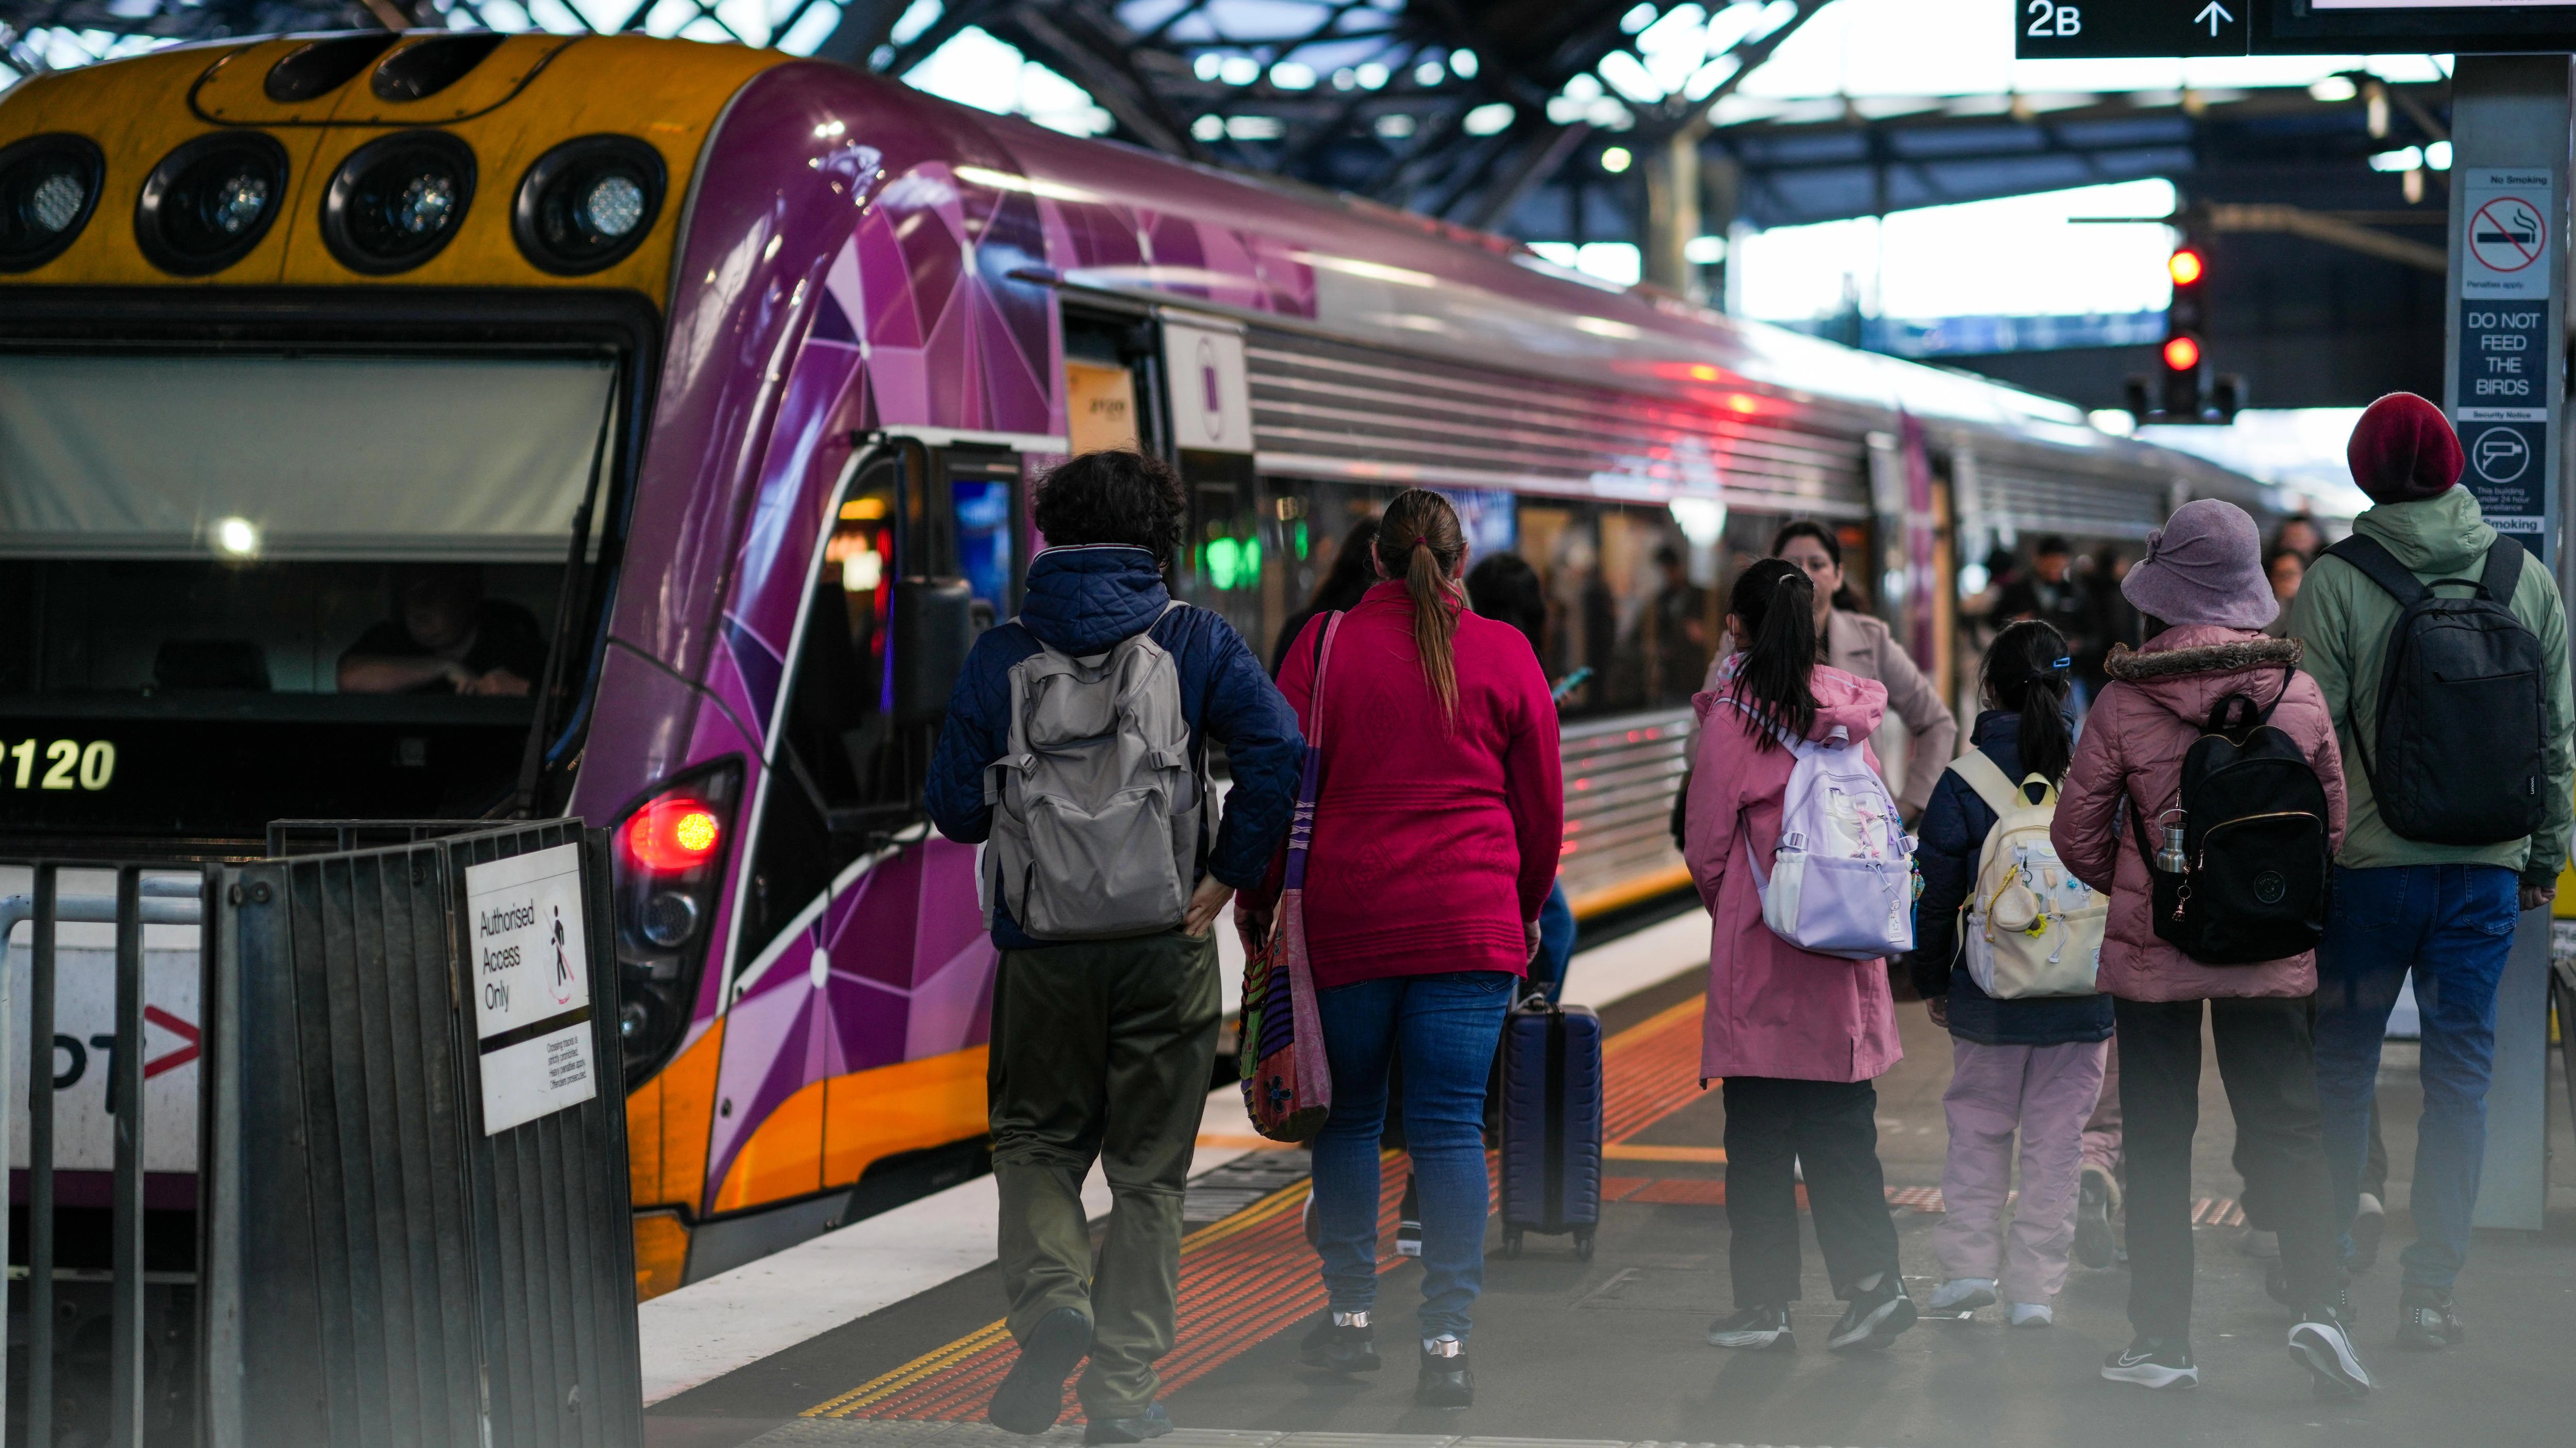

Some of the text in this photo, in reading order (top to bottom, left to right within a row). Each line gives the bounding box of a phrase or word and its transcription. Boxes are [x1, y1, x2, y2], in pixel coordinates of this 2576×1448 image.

[2027, 0, 2081, 36] 2B
[2490, 175, 2547, 186] No Smoking
[2468, 312, 2541, 329] DO NOT
[2481, 334, 2527, 351] FEED
[2485, 356, 2522, 373] THE
[2476, 379, 2529, 396] BIRDS
[2473, 411, 2503, 419] Security
[2477, 486, 2525, 496] This building
[0, 738, 116, 791] 120
[480, 898, 534, 939] Authorised
[483, 945, 521, 975] Access
[485, 979, 510, 1013] Only
[547, 1041, 563, 1053] Crossing
